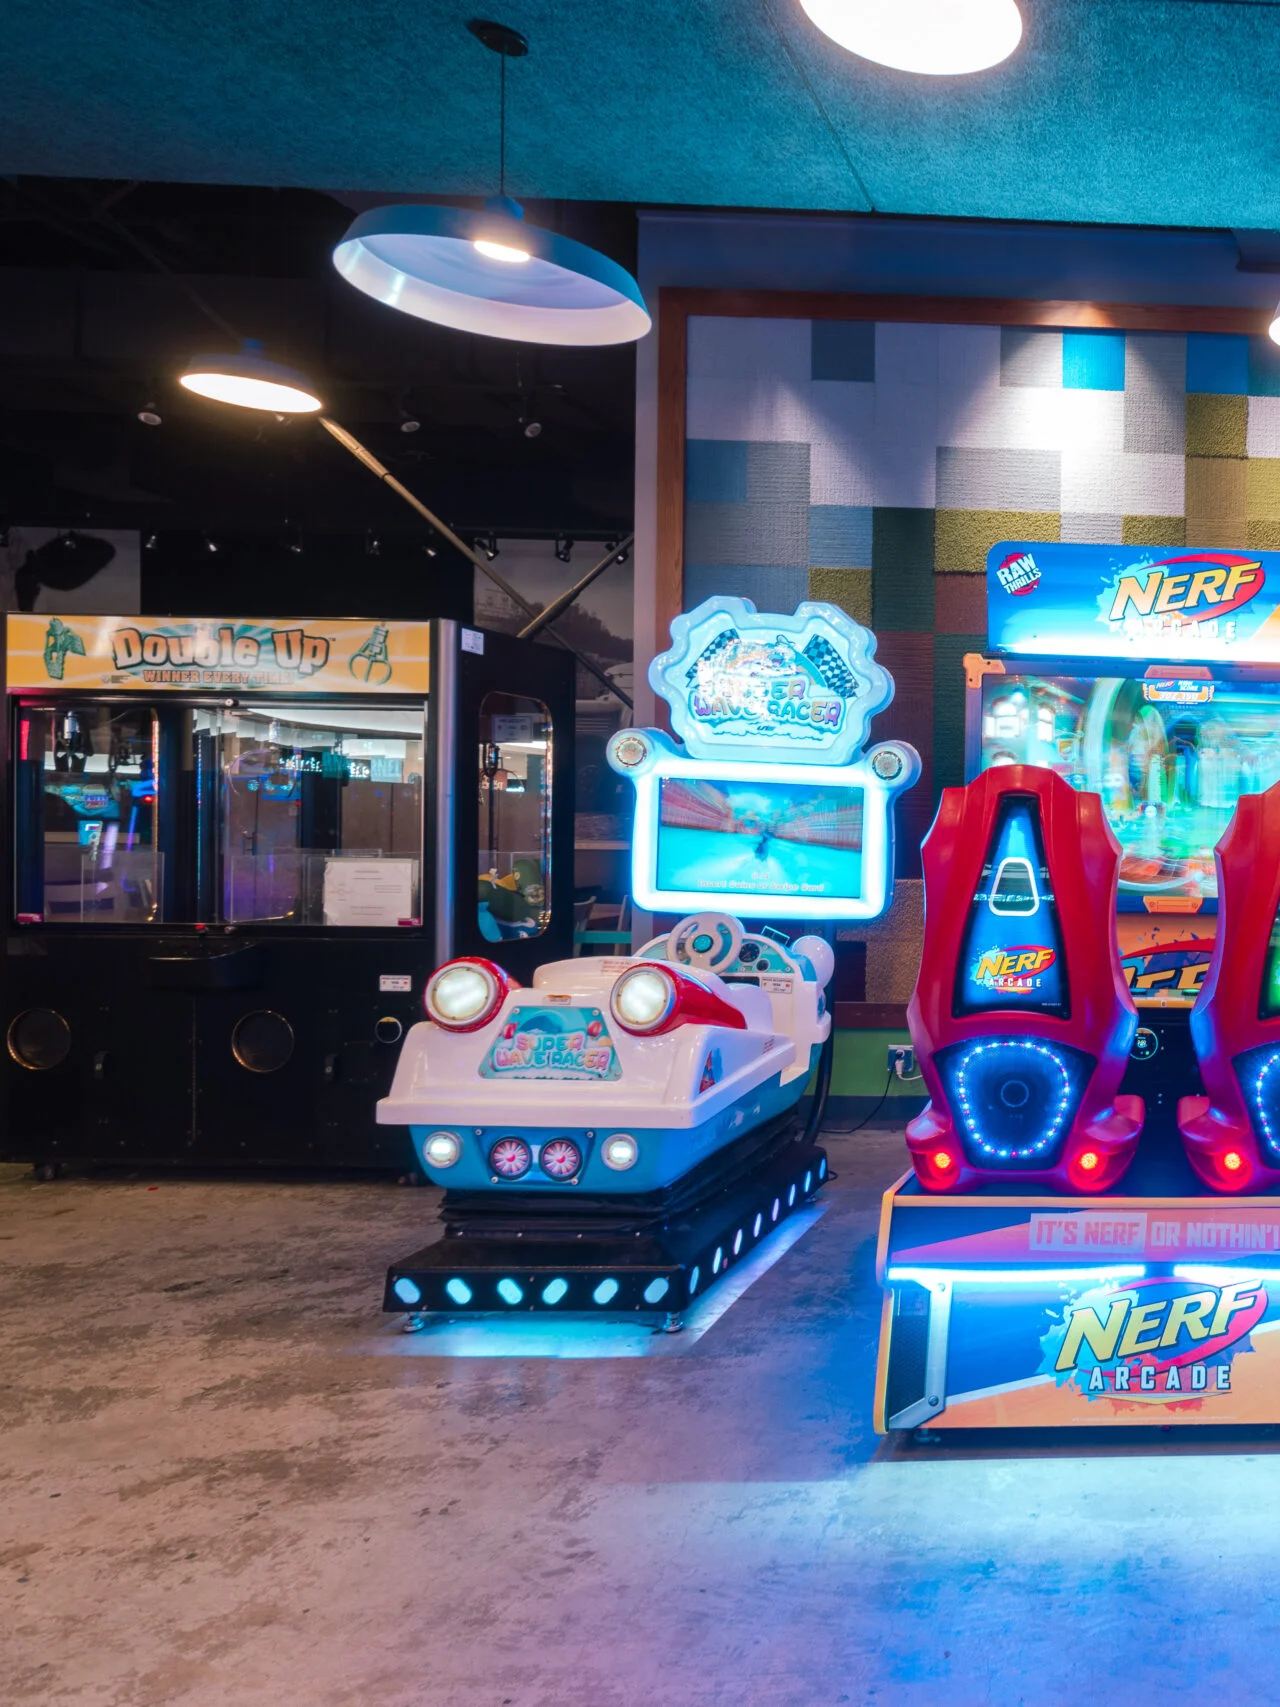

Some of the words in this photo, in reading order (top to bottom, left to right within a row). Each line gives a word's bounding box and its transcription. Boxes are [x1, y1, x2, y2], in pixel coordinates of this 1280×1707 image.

[996, 553, 1036, 586] RAW
[1003, 567, 1042, 594] THRILLS
[1109, 560, 1264, 622] NERF
[112, 627, 261, 670] Double
[271, 628, 330, 674] Up
[143, 670, 200, 683] WINNER
[203, 670, 250, 684] EVERY
[251, 671, 294, 684] TIME!
[767, 700, 841, 727] RACER
[976, 949, 1054, 980] NERF
[989, 978, 1042, 988] ARCADE
[516, 1033, 585, 1051] SUPER
[496, 1050, 546, 1067] WAVE
[551, 1050, 610, 1071] RACER
[1036, 1220, 1078, 1245] IT'S
[1083, 1221, 1141, 1246] NERF
[1151, 1221, 1180, 1247] OR
[1054, 1279, 1263, 1371] NERF
[1087, 1365, 1232, 1392] ARCADE
